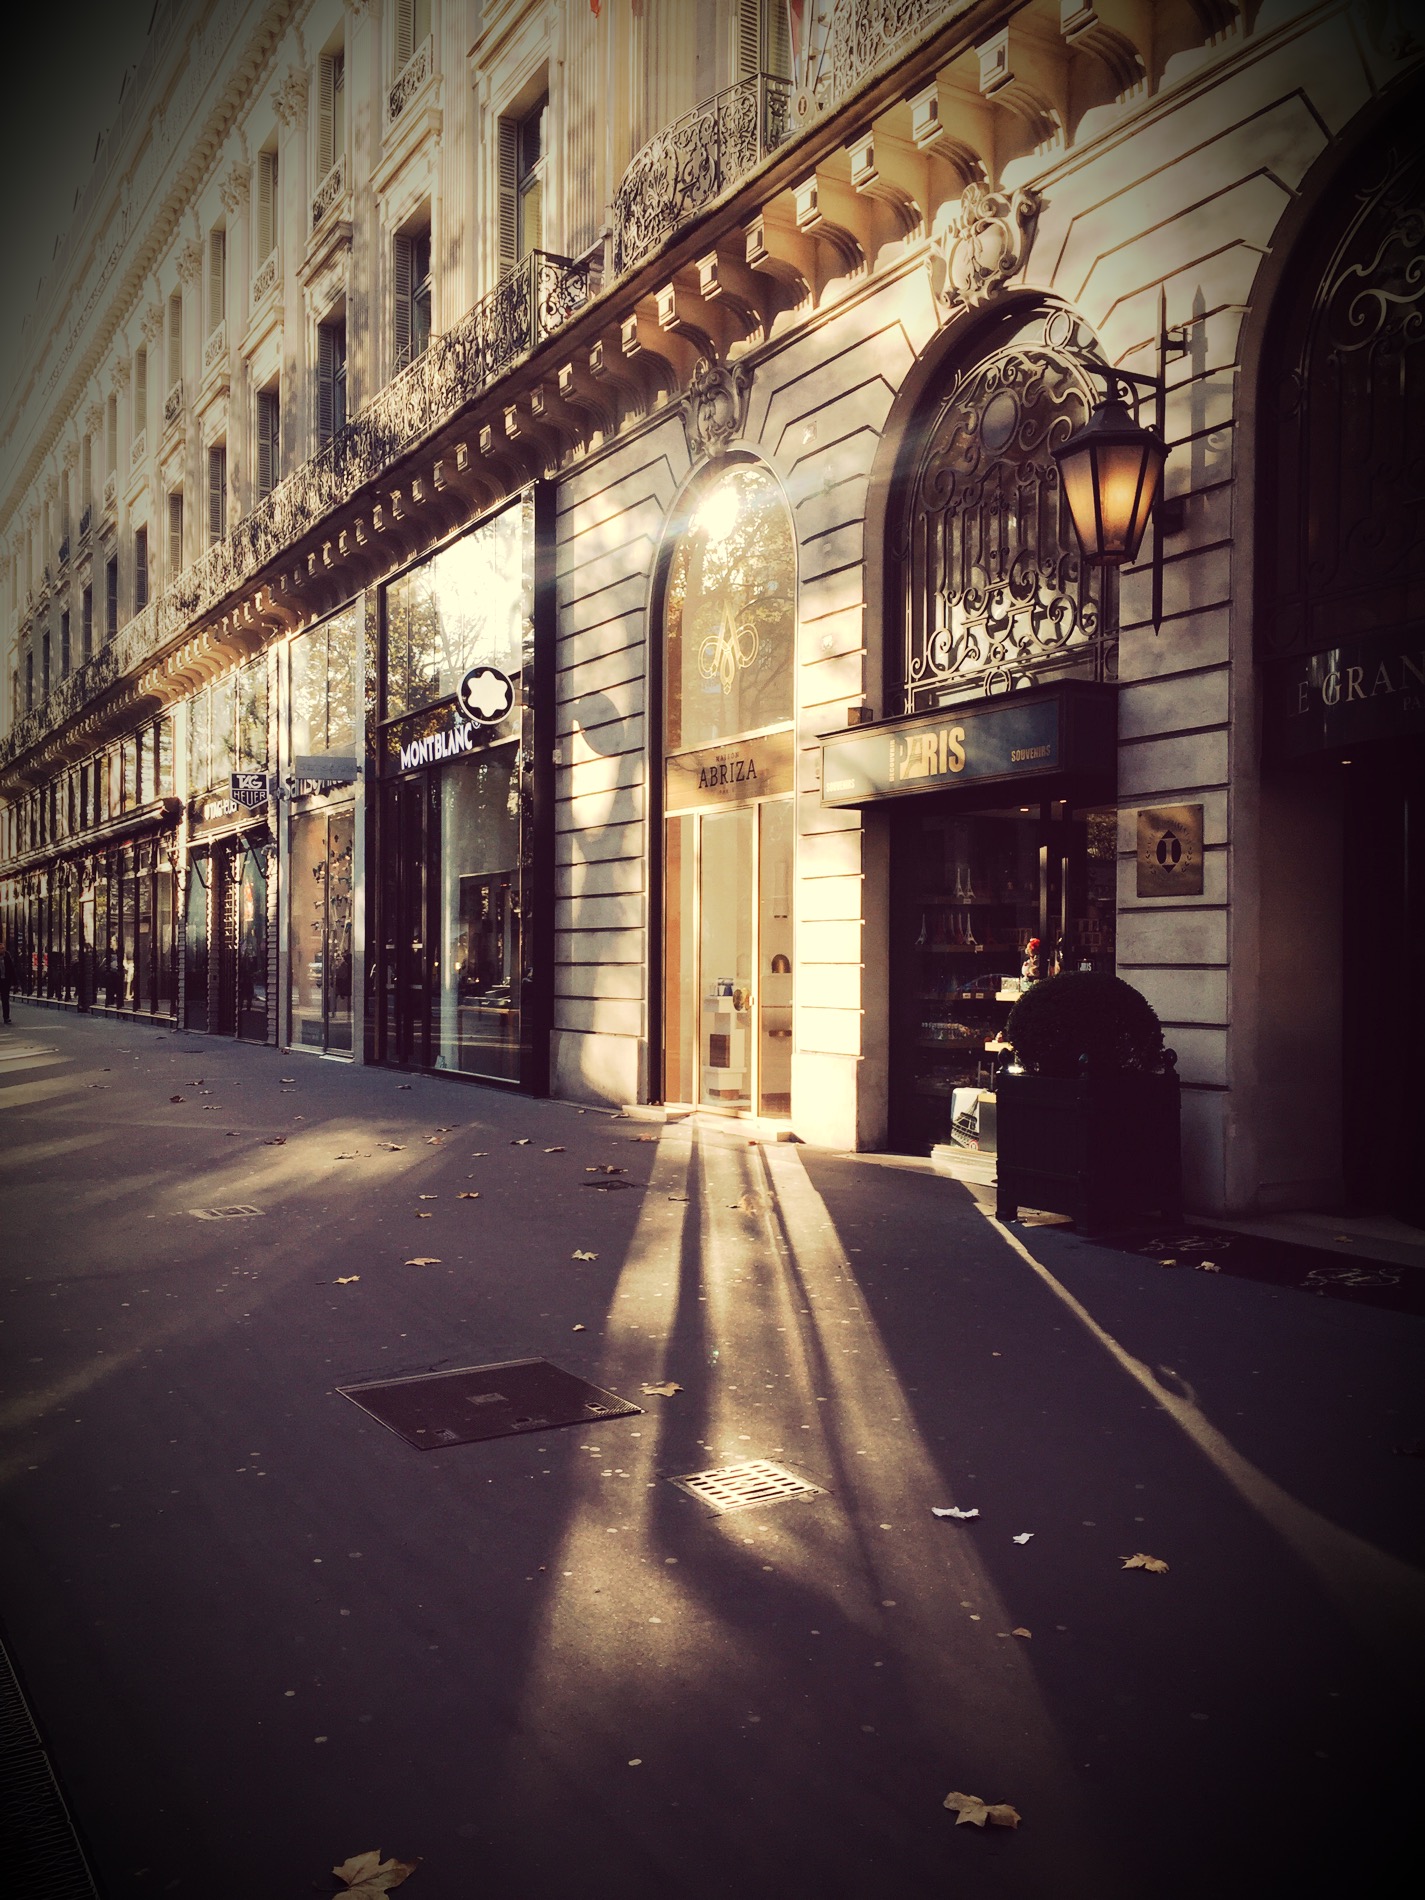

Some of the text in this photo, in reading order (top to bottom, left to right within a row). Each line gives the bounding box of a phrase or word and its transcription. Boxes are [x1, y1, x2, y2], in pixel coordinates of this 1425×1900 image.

[400, 722, 473, 770] MONTBLANC
[1011, 744, 1051, 762] SOUVENIRS
[236, 774, 263, 789] TAG
[698, 758, 757, 789] ABRIZA
[233, 790, 266, 807] HEUER
